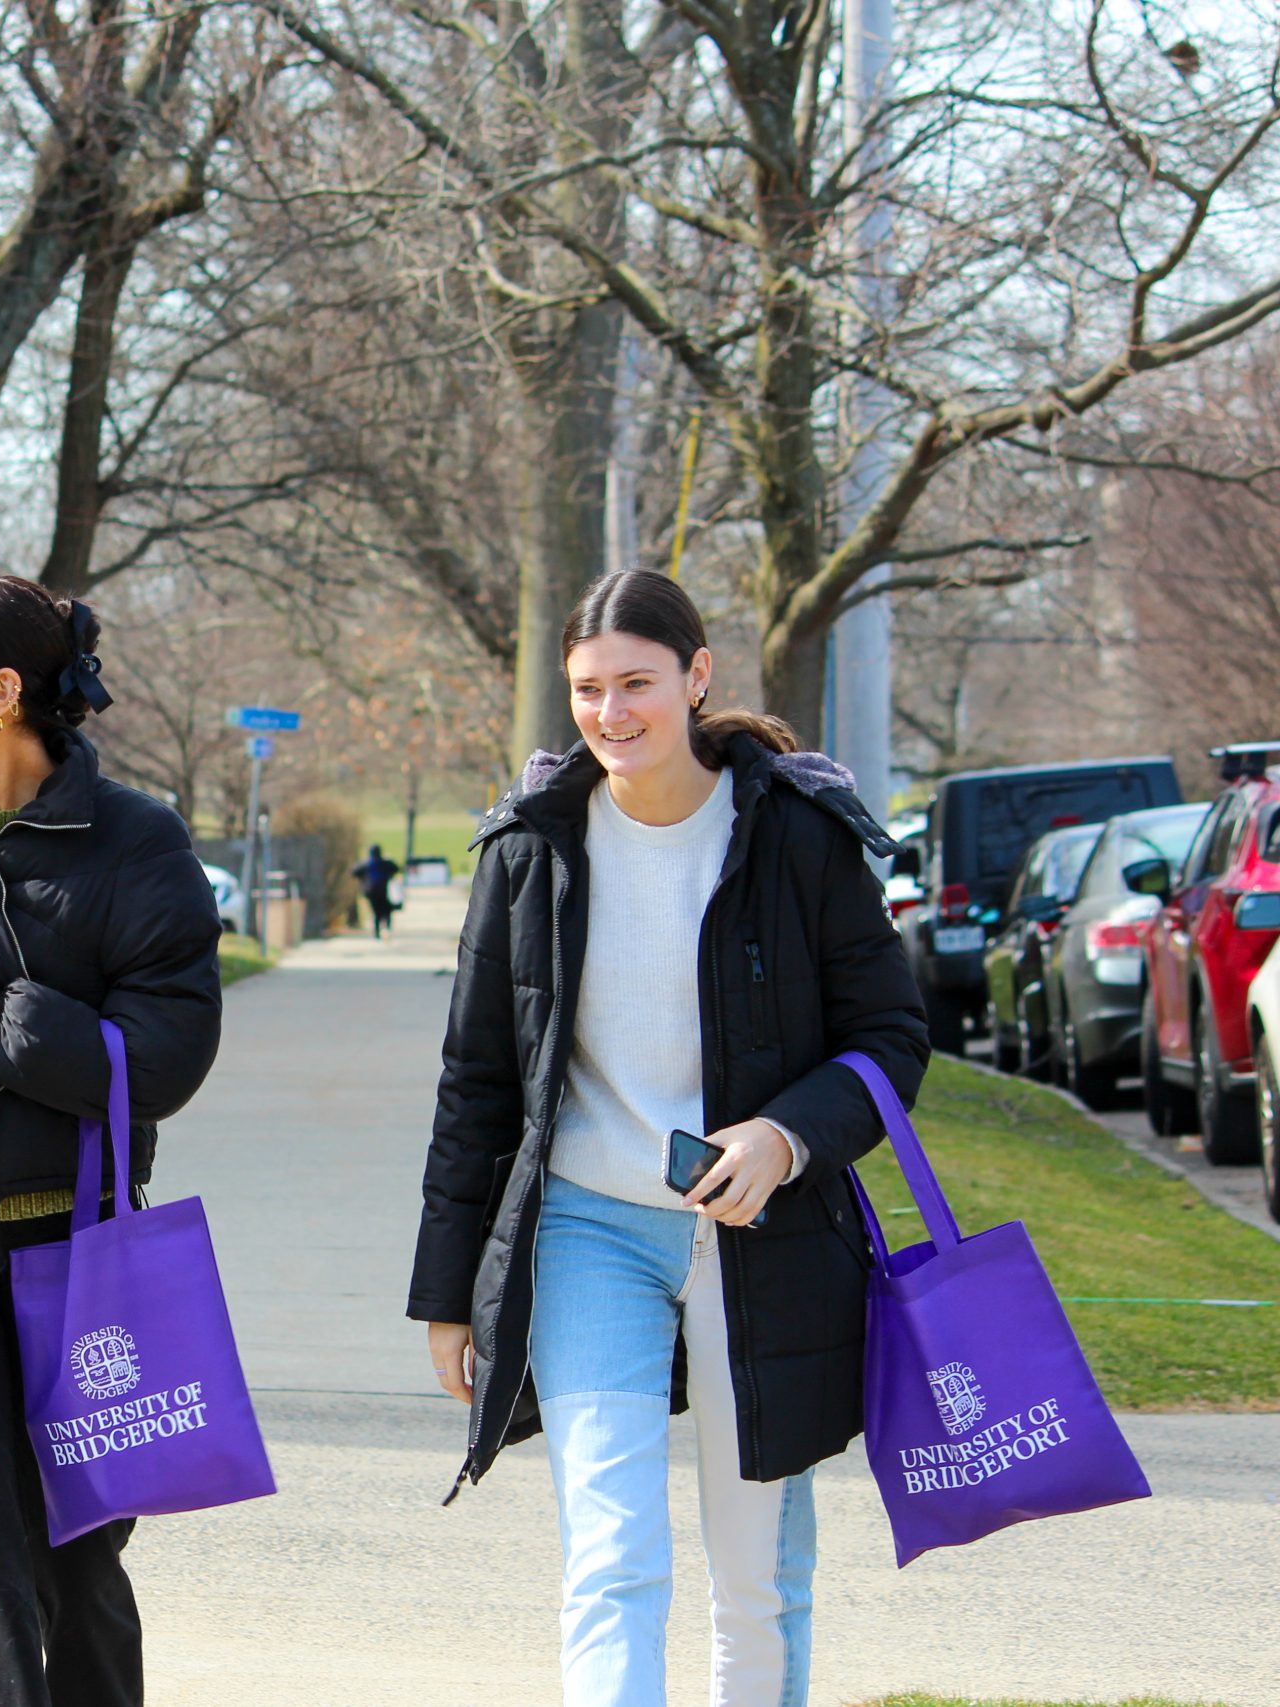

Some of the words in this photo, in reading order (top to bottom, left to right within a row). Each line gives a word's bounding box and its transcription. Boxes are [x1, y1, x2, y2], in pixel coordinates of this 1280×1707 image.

[70, 1325, 126, 1370] UNIVERSITY
[123, 1333, 136, 1351] OF
[925, 1361, 964, 1381] ERSITY
[961, 1366, 977, 1382] OF
[77, 1364, 142, 1400] BRIDGEPORT
[45, 1390, 171, 1442] UNIVERSITY
[173, 1381, 203, 1407] OF
[51, 1402, 208, 1466] BRIDGEPORT
[898, 1413, 1026, 1469] UNIVERSITY
[1027, 1397, 1060, 1426] OF
[945, 1395, 987, 1436] DGEPORT
[902, 1417, 1071, 1495] BRIDGEPORT
